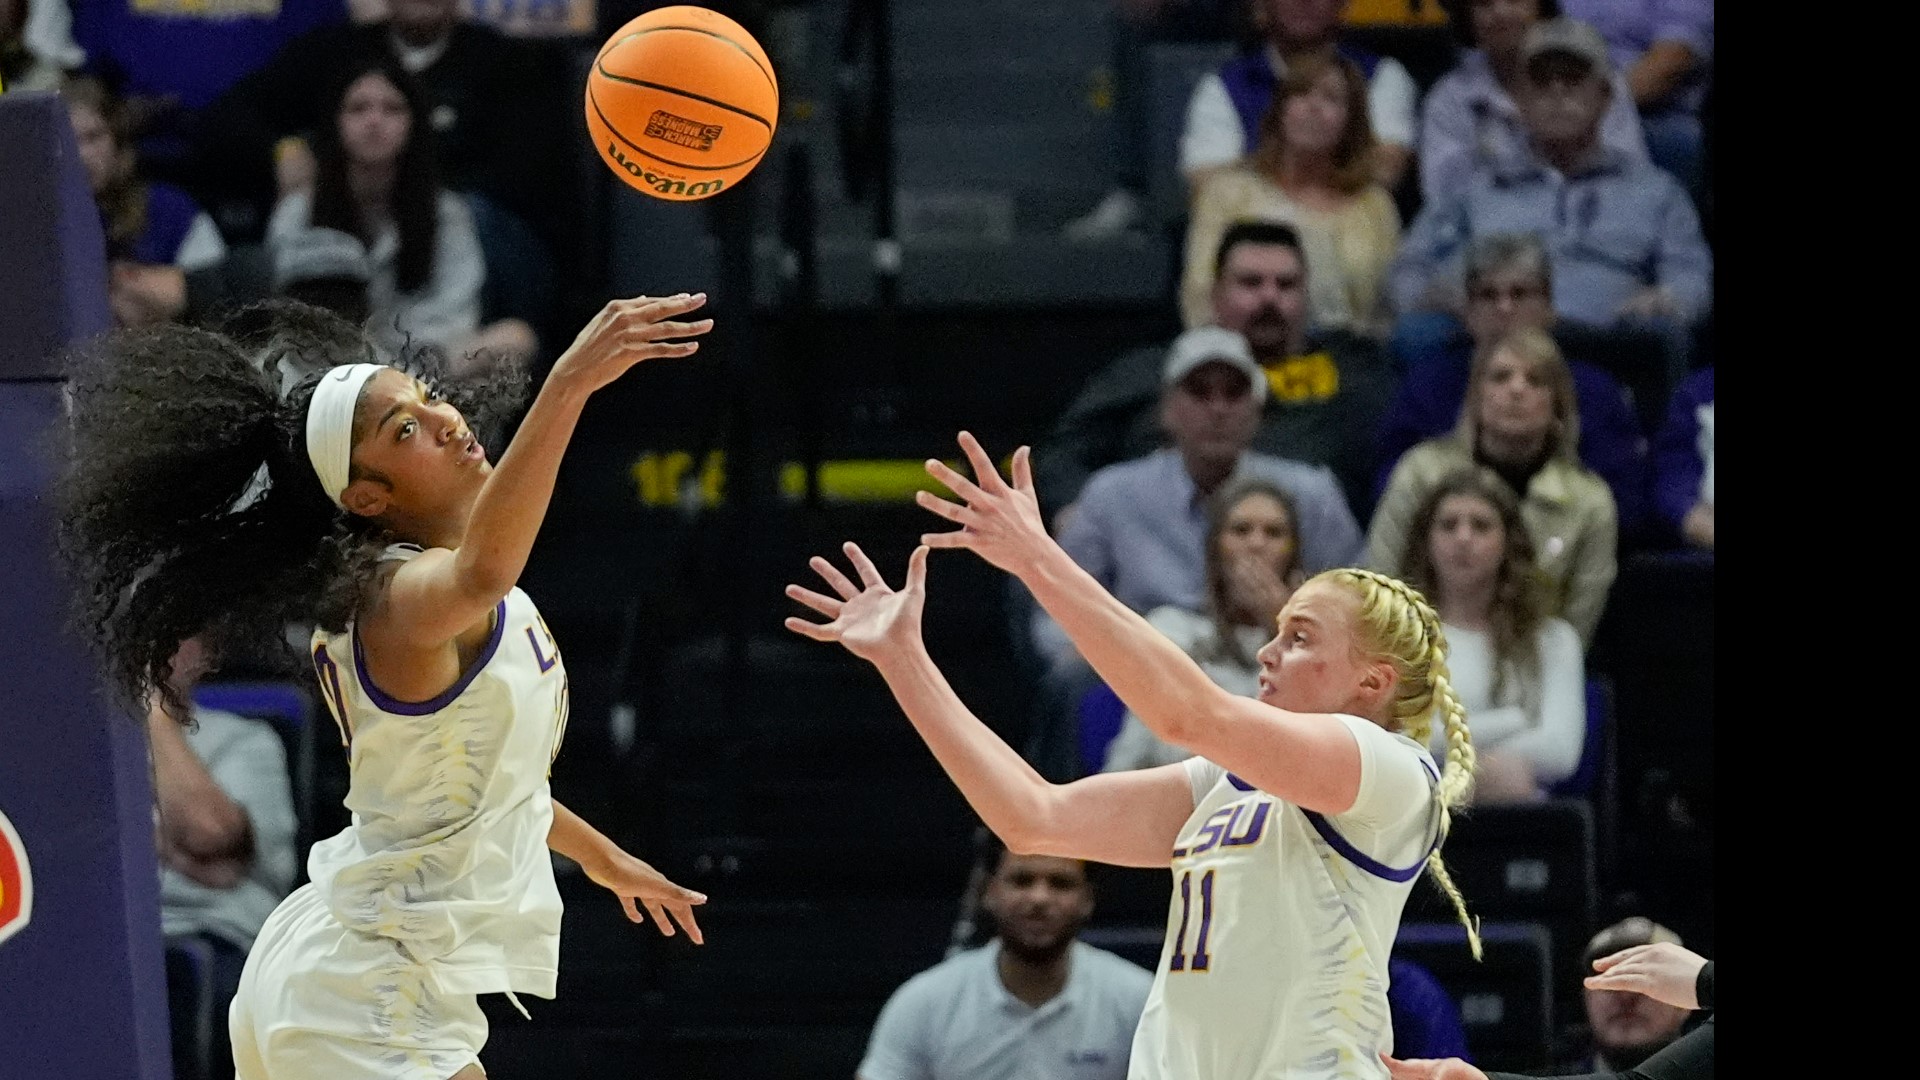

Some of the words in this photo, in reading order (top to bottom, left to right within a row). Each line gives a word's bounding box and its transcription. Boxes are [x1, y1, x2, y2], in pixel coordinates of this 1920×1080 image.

[650, 113, 701, 138] MADNESS
[663, 129, 702, 149] MARCH
[608, 141, 723, 196] Wilson
[1168, 868, 1216, 973] 11
